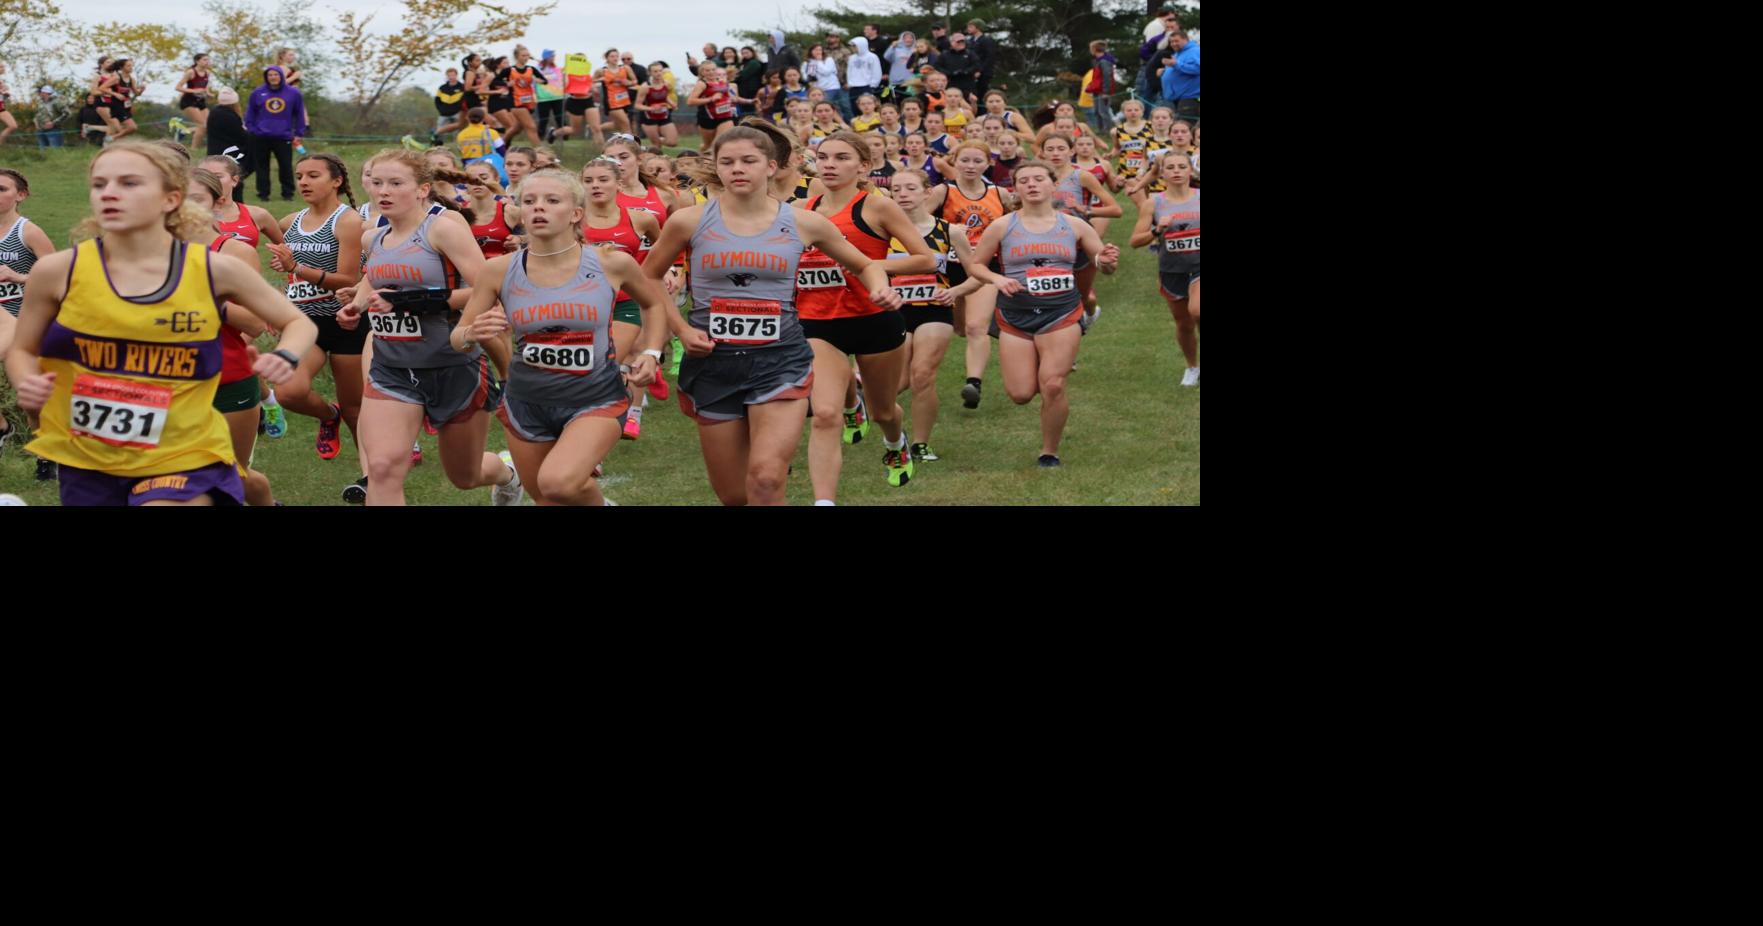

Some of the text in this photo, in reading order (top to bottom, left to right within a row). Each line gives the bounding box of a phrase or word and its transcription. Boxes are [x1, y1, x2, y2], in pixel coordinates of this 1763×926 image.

[1010, 243, 1071, 256] PLYMOUTH
[702, 250, 788, 273] PLYMOUTH
[798, 269, 843, 285] 3704
[1029, 276, 1070, 291] 3681
[511, 302, 599, 324] PLYMOUTH
[372, 314, 419, 334] 3679
[712, 316, 777, 337] 3675
[74, 337, 200, 378] TWO RIVERS
[525, 346, 591, 367] 3680
[73, 400, 156, 437] 3731
